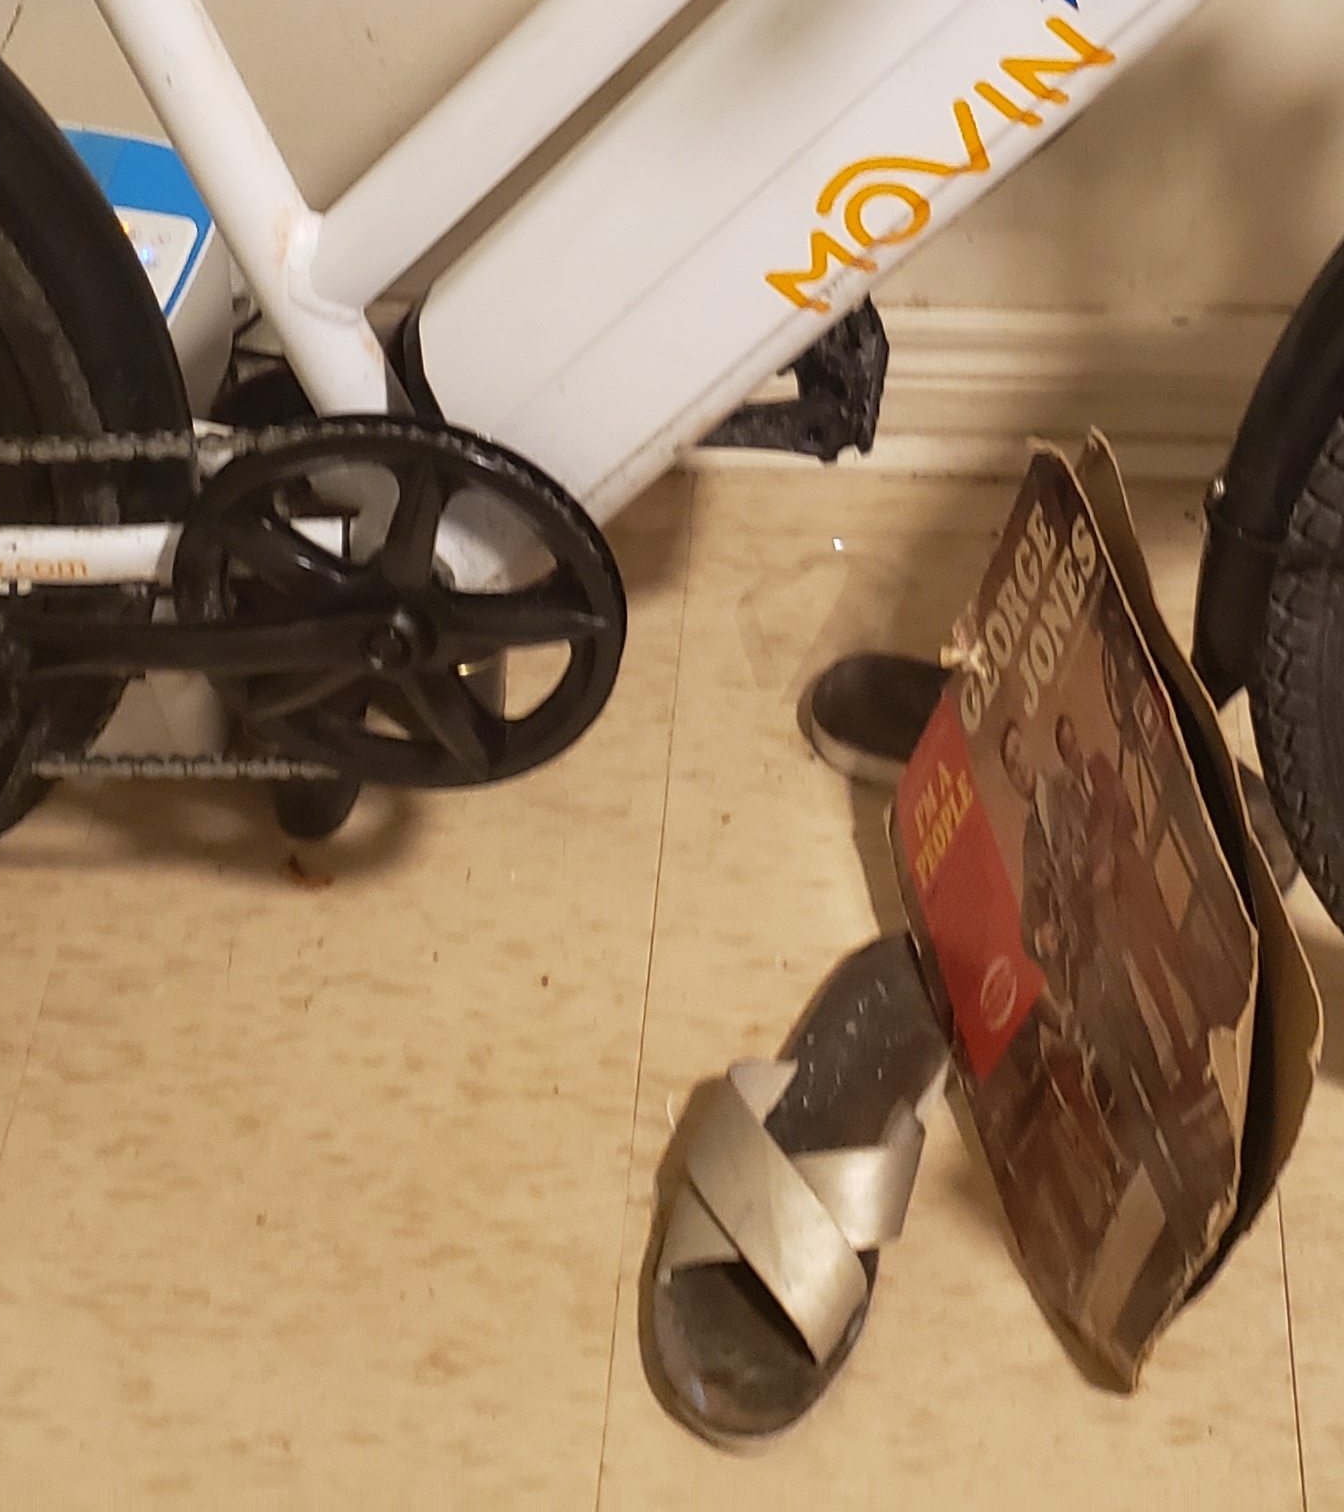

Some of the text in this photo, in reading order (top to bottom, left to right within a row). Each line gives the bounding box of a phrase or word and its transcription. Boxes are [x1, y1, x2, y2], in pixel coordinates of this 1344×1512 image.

[960, 500, 1056, 733] GEORGE
[1018, 513, 1096, 718] JONES
[915, 769, 973, 891] PEOPLE
[937, 761, 952, 799] A
